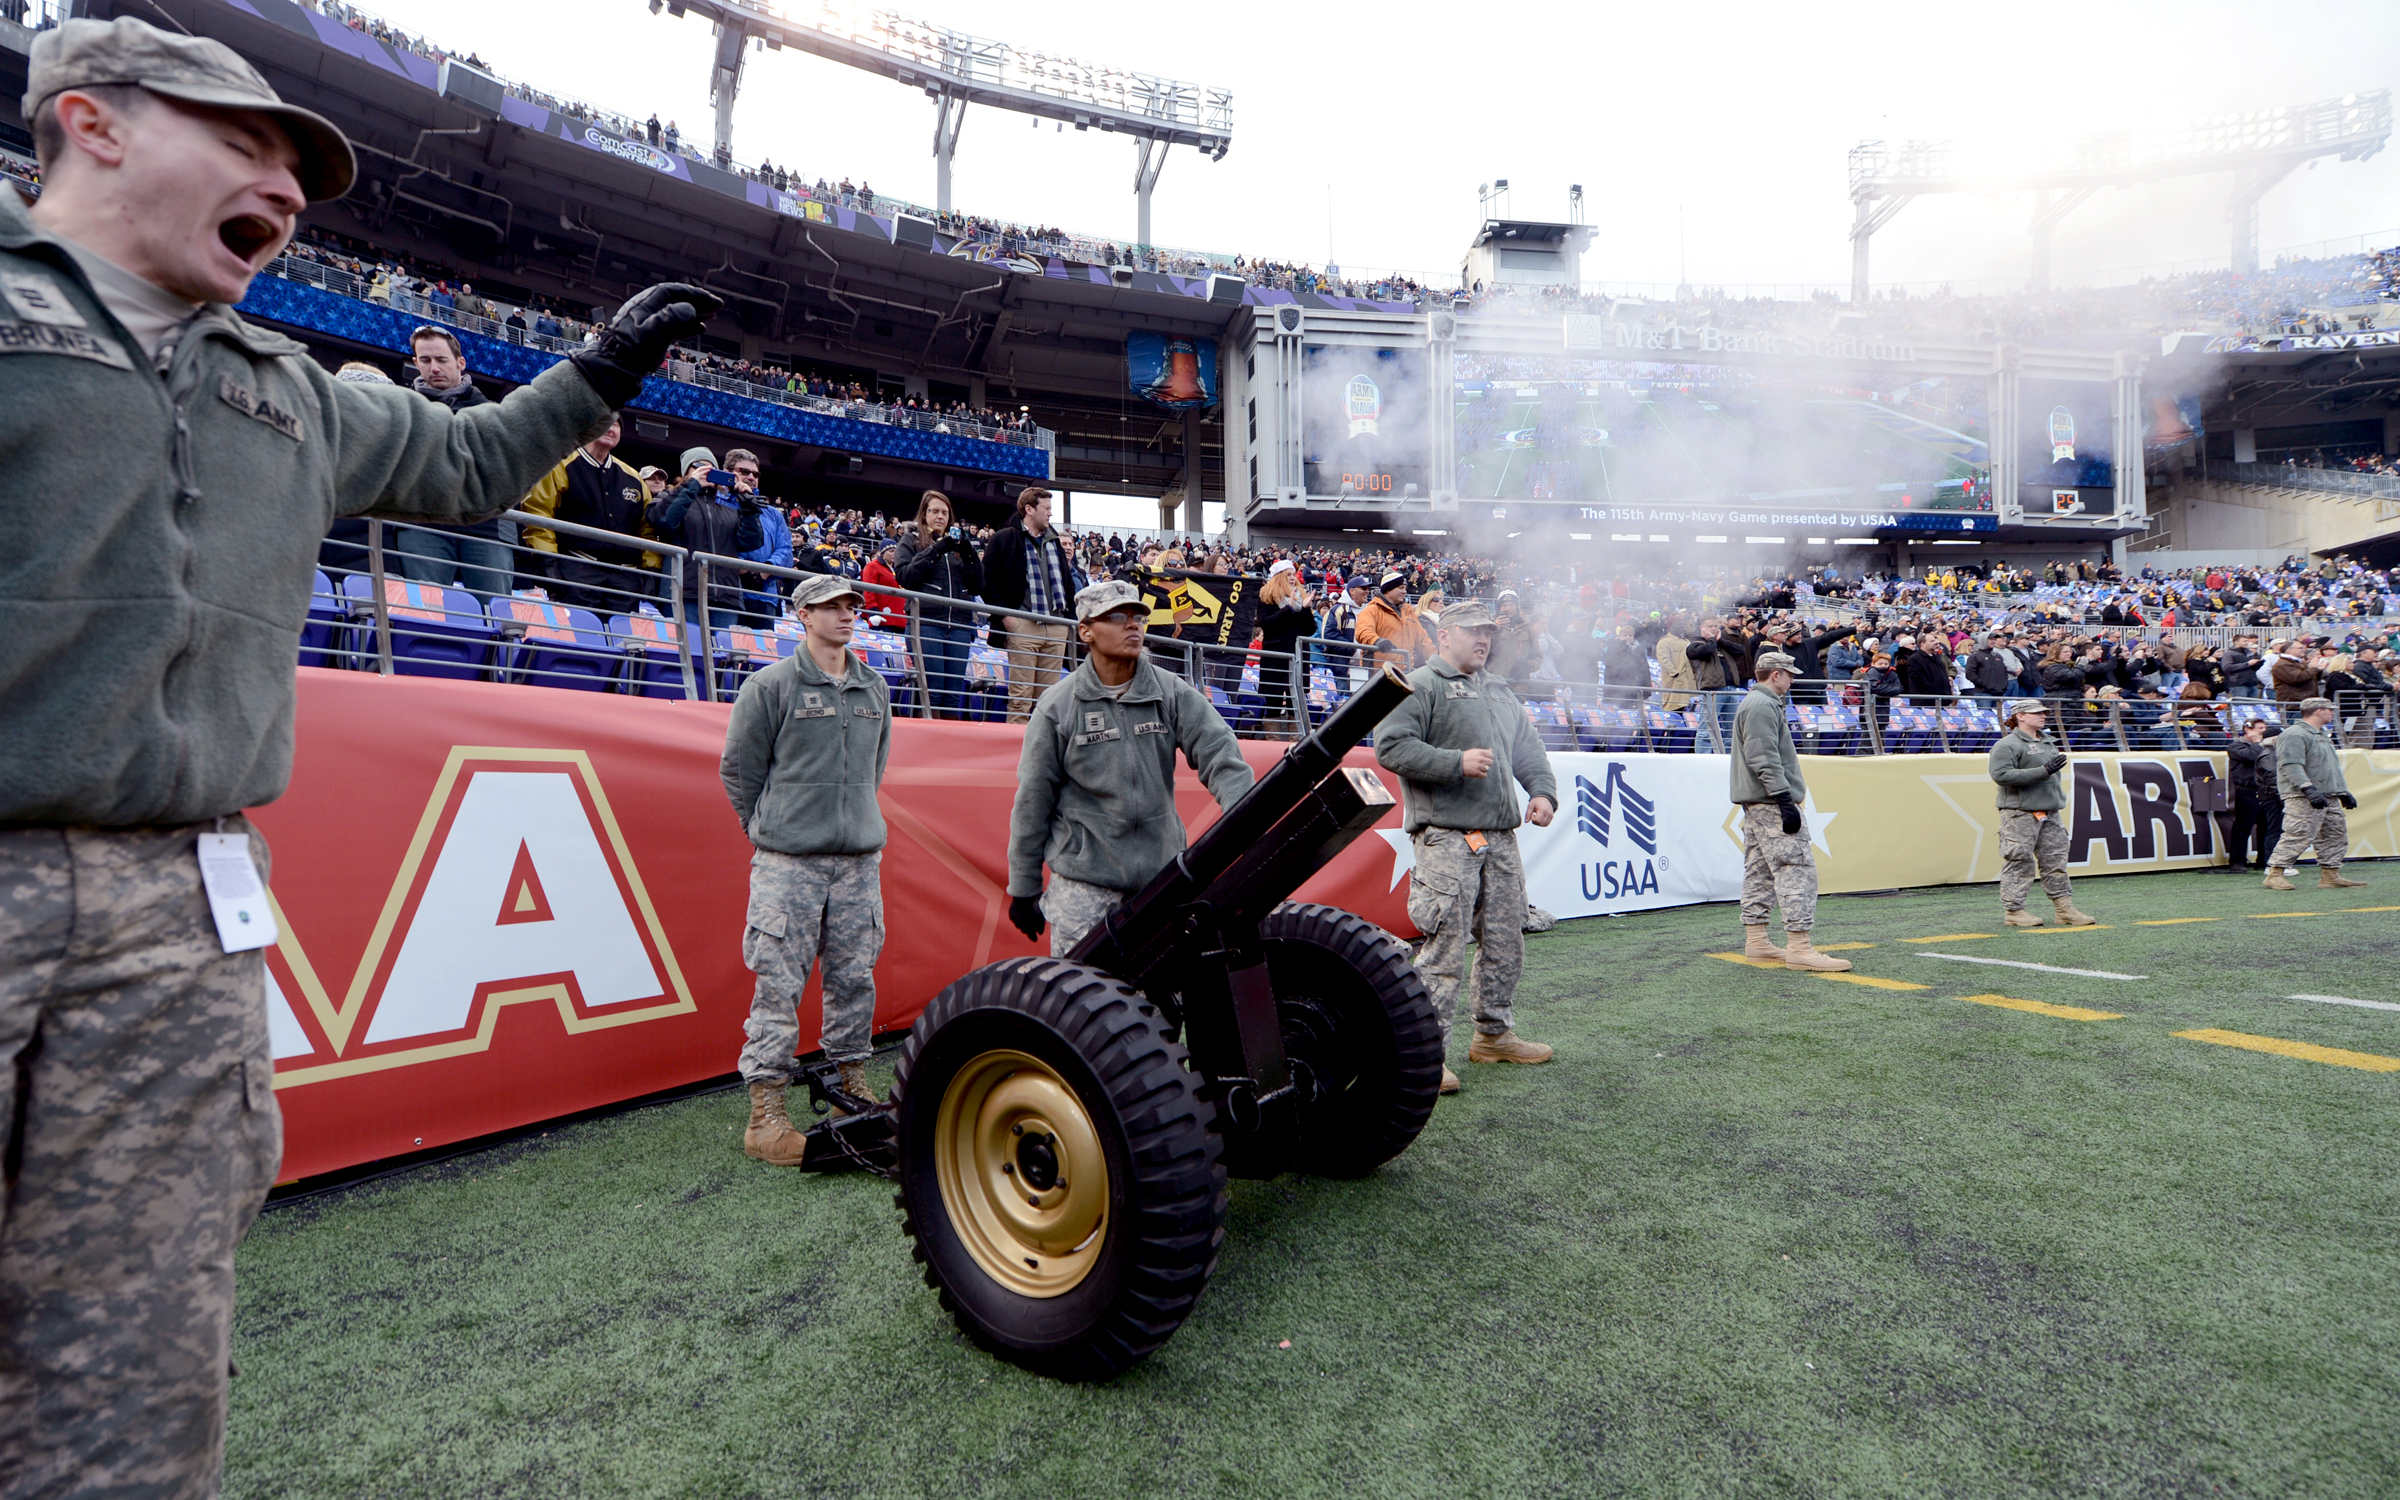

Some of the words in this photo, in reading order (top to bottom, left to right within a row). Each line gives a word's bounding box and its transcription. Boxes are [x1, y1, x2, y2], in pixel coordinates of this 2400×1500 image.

[600, 143, 665, 170] SPORTSNET
[779, 202, 805, 218] NEWS
[804, 200, 823, 221] 11
[1615, 322, 1687, 350] M&T
[1700, 326, 1782, 354] Bank
[1792, 335, 1917, 361] Stadium
[1580, 507, 1606, 519] The
[1610, 508, 1645, 520] 115th
[1648, 509, 1724, 523] Army-Navy
[1728, 511, 1767, 523] Game
[1771, 513, 1837, 525] presented
[1840, 514, 1857, 527] by
[1860, 514, 1898, 526] USAA
[1229, 580, 1243, 604] GO
[1216, 605, 1236, 647] ARM
[1580, 859, 1660, 902] USAA
